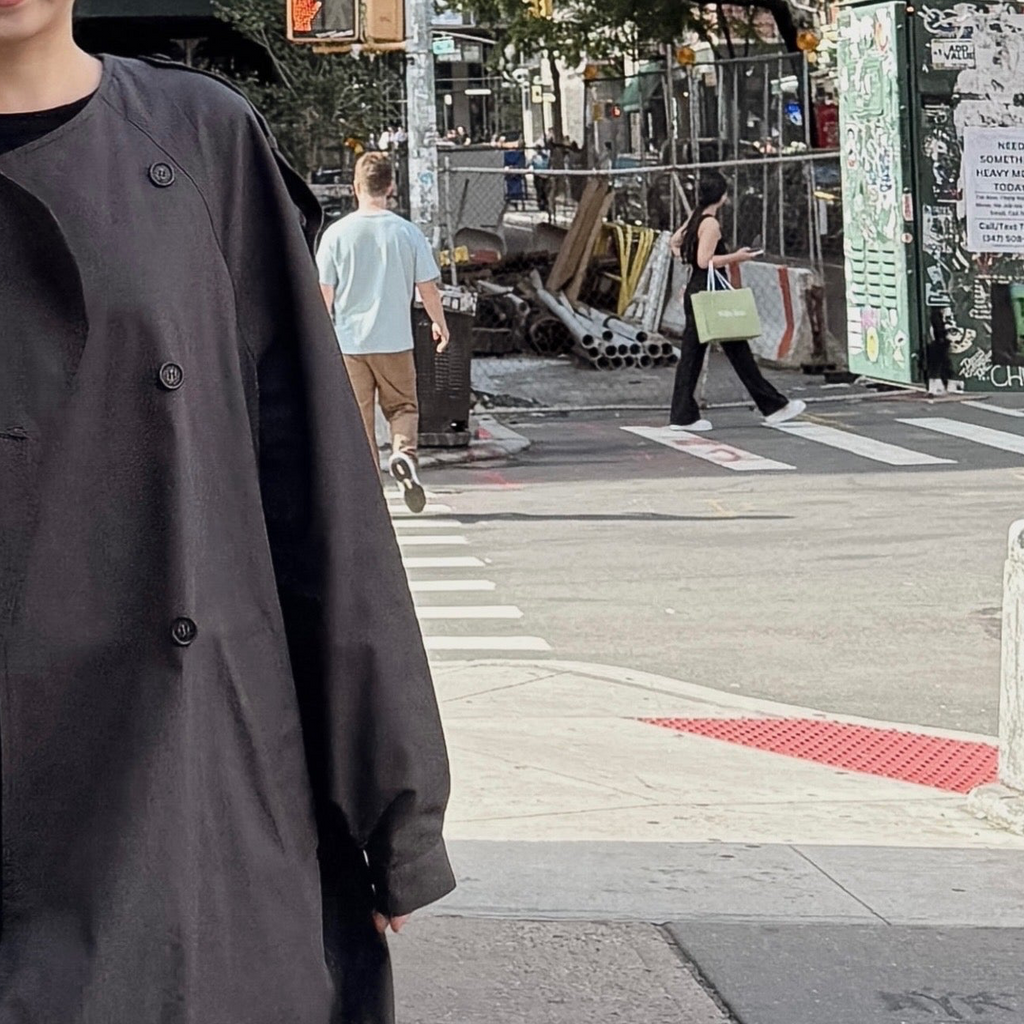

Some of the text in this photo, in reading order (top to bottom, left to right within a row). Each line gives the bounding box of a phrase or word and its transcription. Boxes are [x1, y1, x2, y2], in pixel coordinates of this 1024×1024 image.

[998, 141, 1024, 151] NEED
[976, 169, 1009, 178] HEAVY
[994, 183, 1024, 192] TODA
[990, 364, 1024, 387] CH
